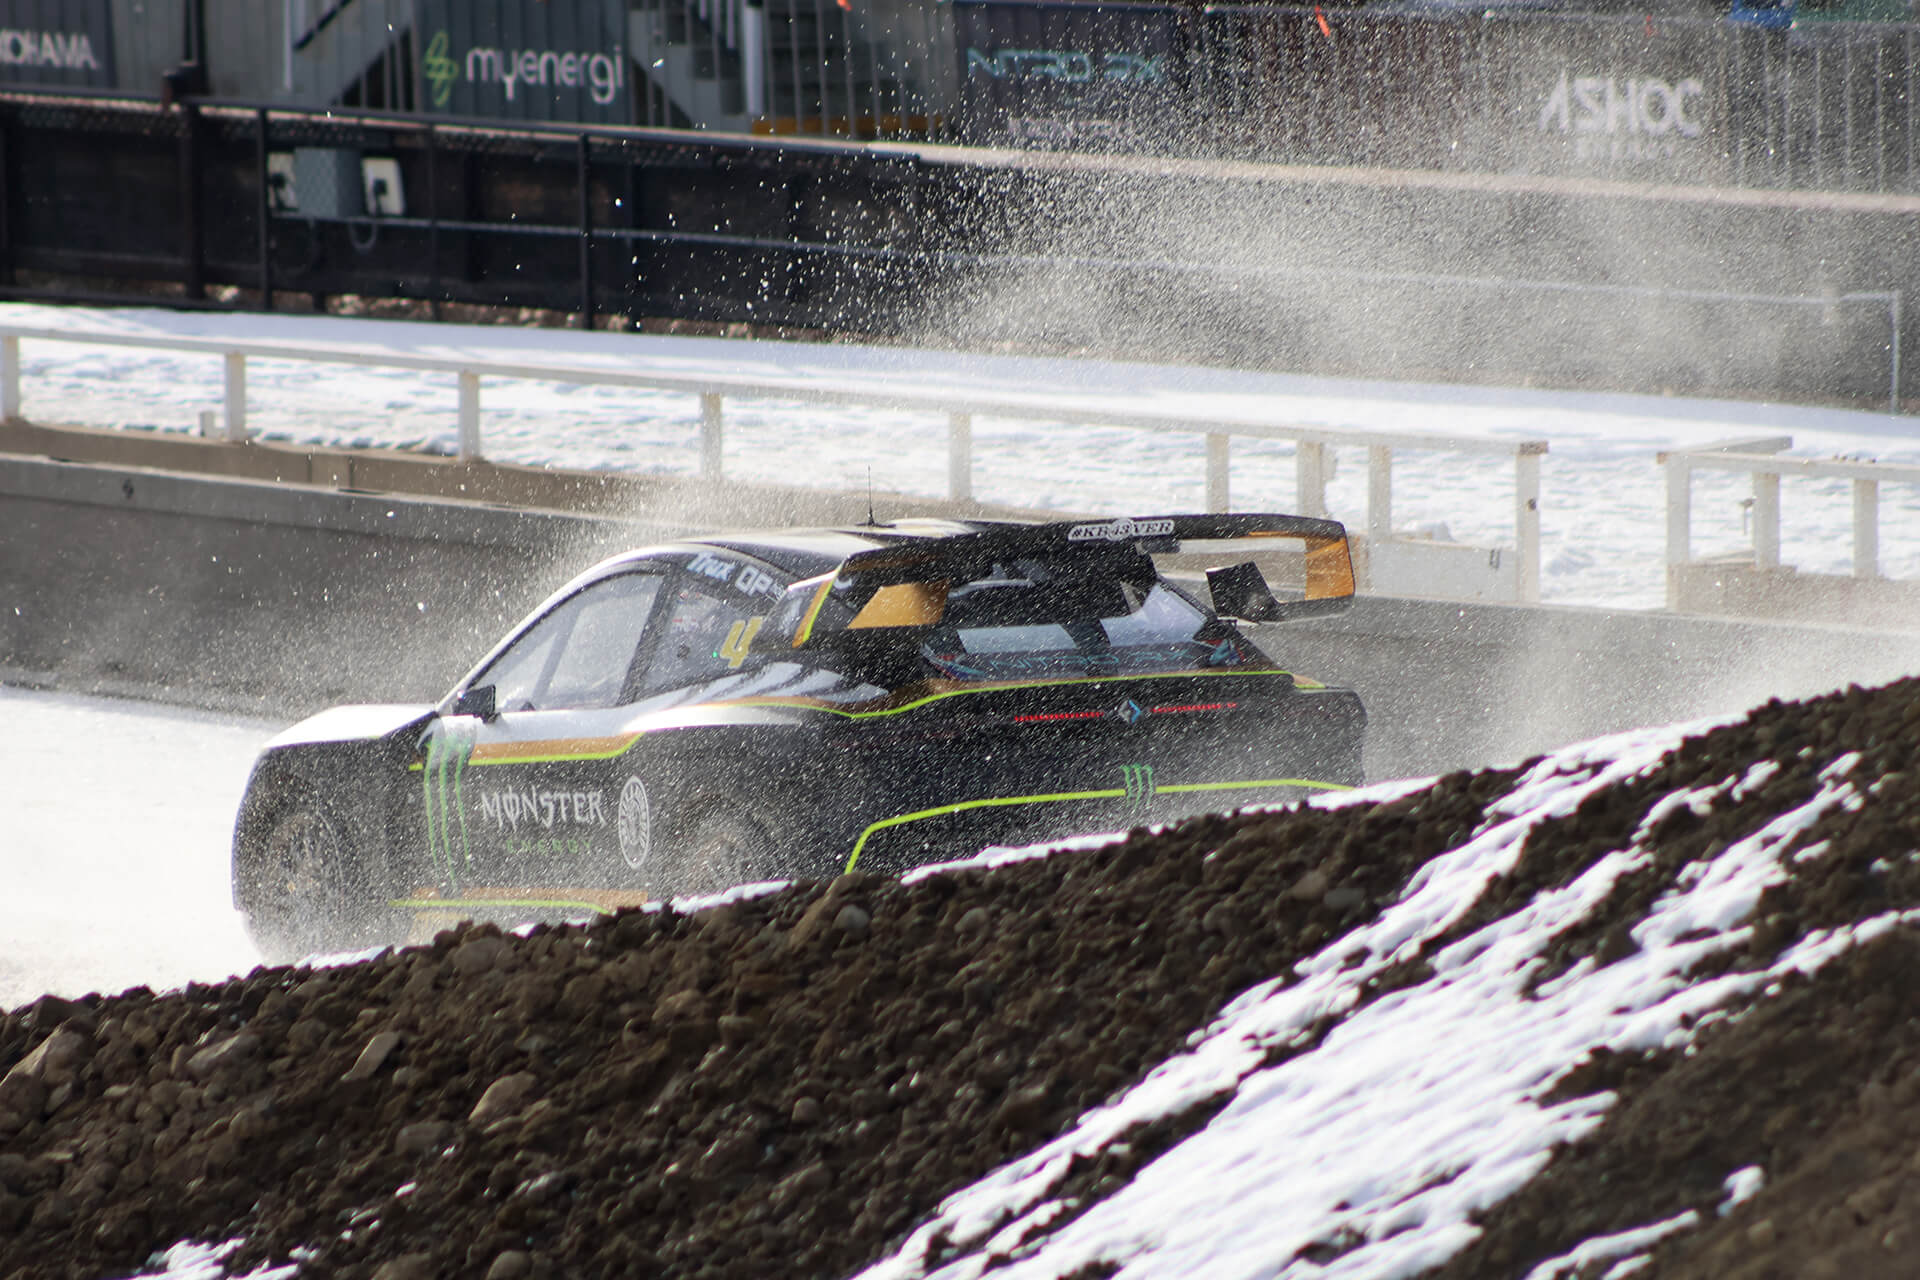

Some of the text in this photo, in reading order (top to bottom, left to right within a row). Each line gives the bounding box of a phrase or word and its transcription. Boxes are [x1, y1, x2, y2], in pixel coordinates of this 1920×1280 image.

[466, 46, 623, 104] myenergi
[967, 48, 1091, 82] NITRO
[1538, 70, 1704, 137] ASHOC
[720, 616, 763, 669] 4
[990, 653, 1119, 672] NITRO
[481, 784, 607, 833] MONSTER
[505, 839, 594, 854] ENERGY
